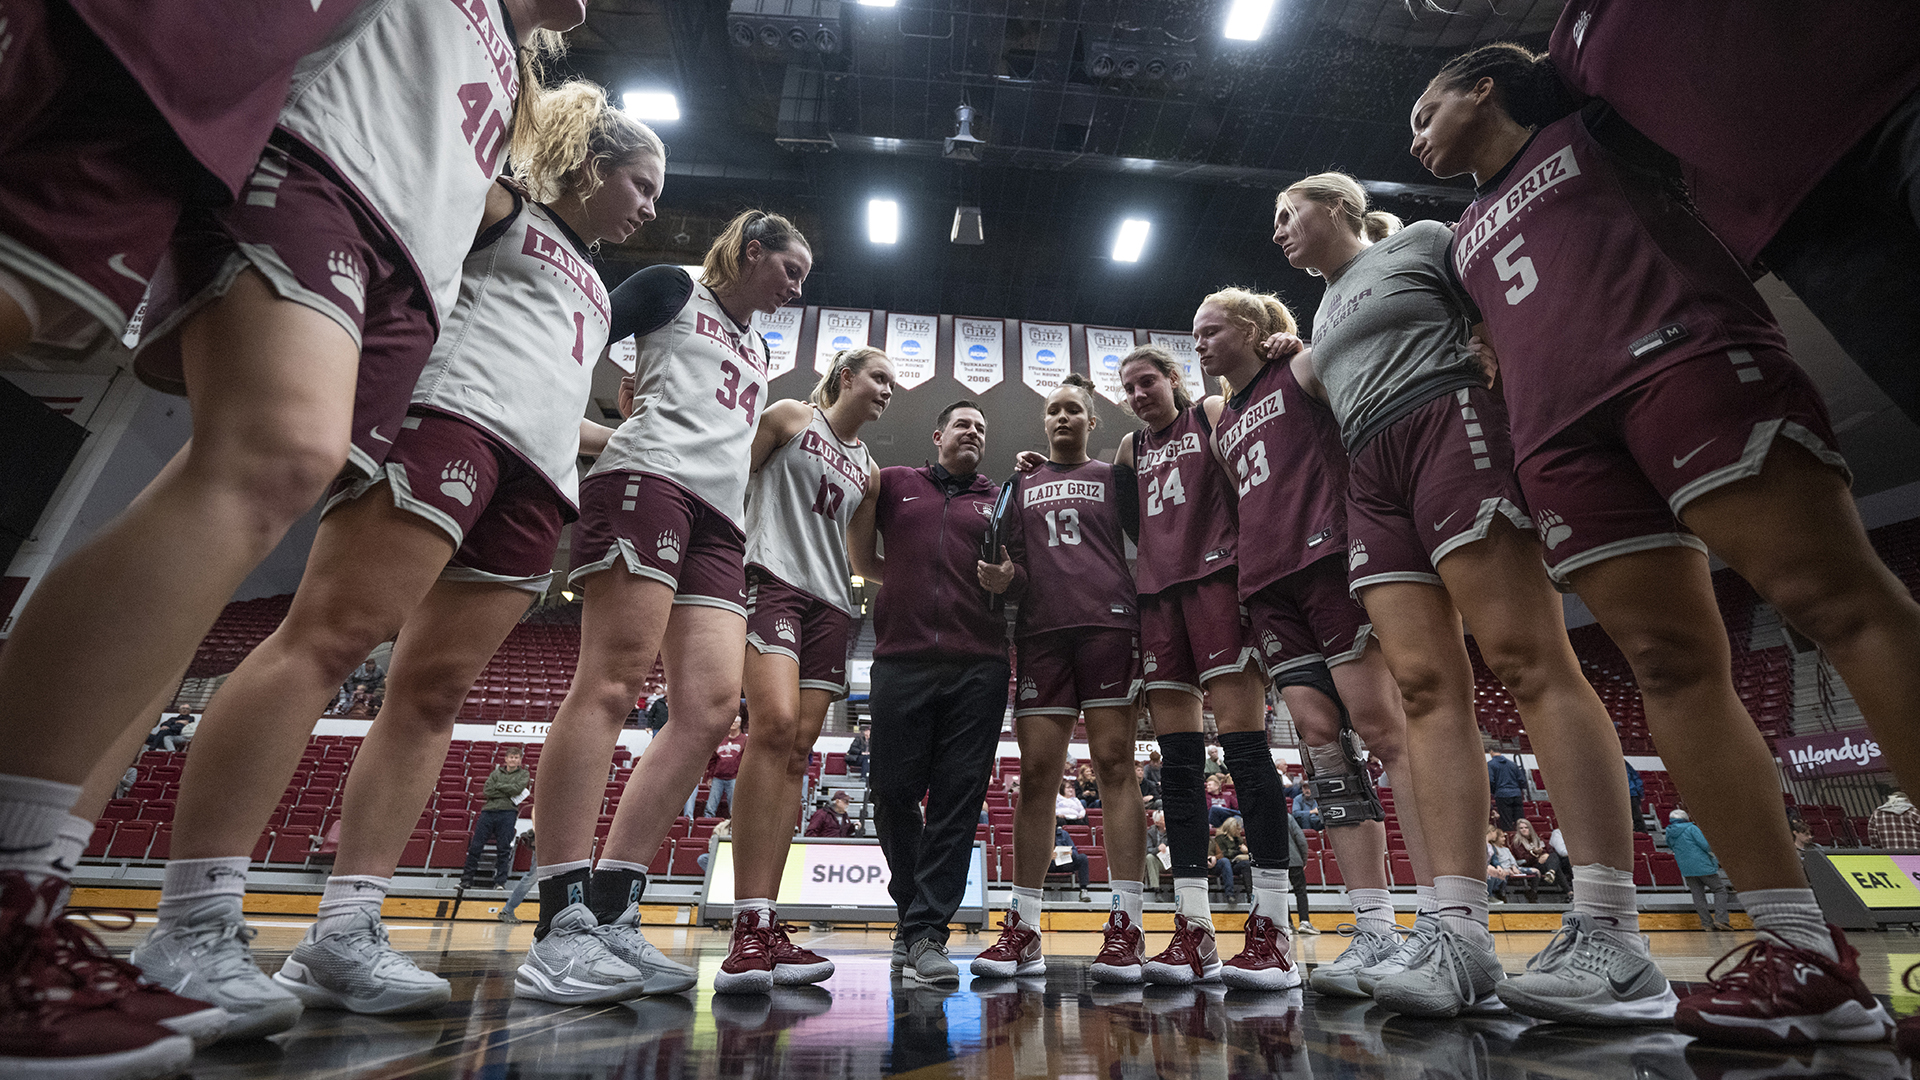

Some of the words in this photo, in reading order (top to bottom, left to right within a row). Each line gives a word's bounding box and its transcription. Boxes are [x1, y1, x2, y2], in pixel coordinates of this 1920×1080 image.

[457, 82, 507, 180] 40
[1460, 206, 1500, 269] LADY
[1506, 156, 1566, 214] GRIZ
[533, 233, 589, 289] LADY
[1492, 233, 1539, 305] 5
[761, 312, 795, 324] GRIZ
[828, 316, 862, 328] GRIZ
[896, 319, 930, 332] GRIZ
[571, 311, 585, 366] 1
[962, 325, 996, 337] GRIZ
[1030, 330, 1063, 342] GRIZ
[1095, 335, 1128, 347] GRIZ
[1666, 326, 1680, 337] M
[898, 370, 921, 379] 2010
[967, 374, 991, 383] 2006
[1035, 379, 1060, 388] 2005
[716, 360, 760, 428] 34
[1245, 395, 1279, 429] GRIZ
[806, 434, 841, 466] LADY
[842, 459, 866, 490] GRIZ
[1237, 440, 1271, 500] 23
[1027, 483, 1063, 503] LADY
[1067, 482, 1100, 498] GRIZ
[1147, 467, 1187, 517] 24
[1045, 508, 1081, 547] 13
[497, 723, 526, 733] SEC.
[1788, 736, 1882, 773] Wendy's
[811, 864, 885, 883] SHOP.
[1851, 871, 1902, 889] EAT.
